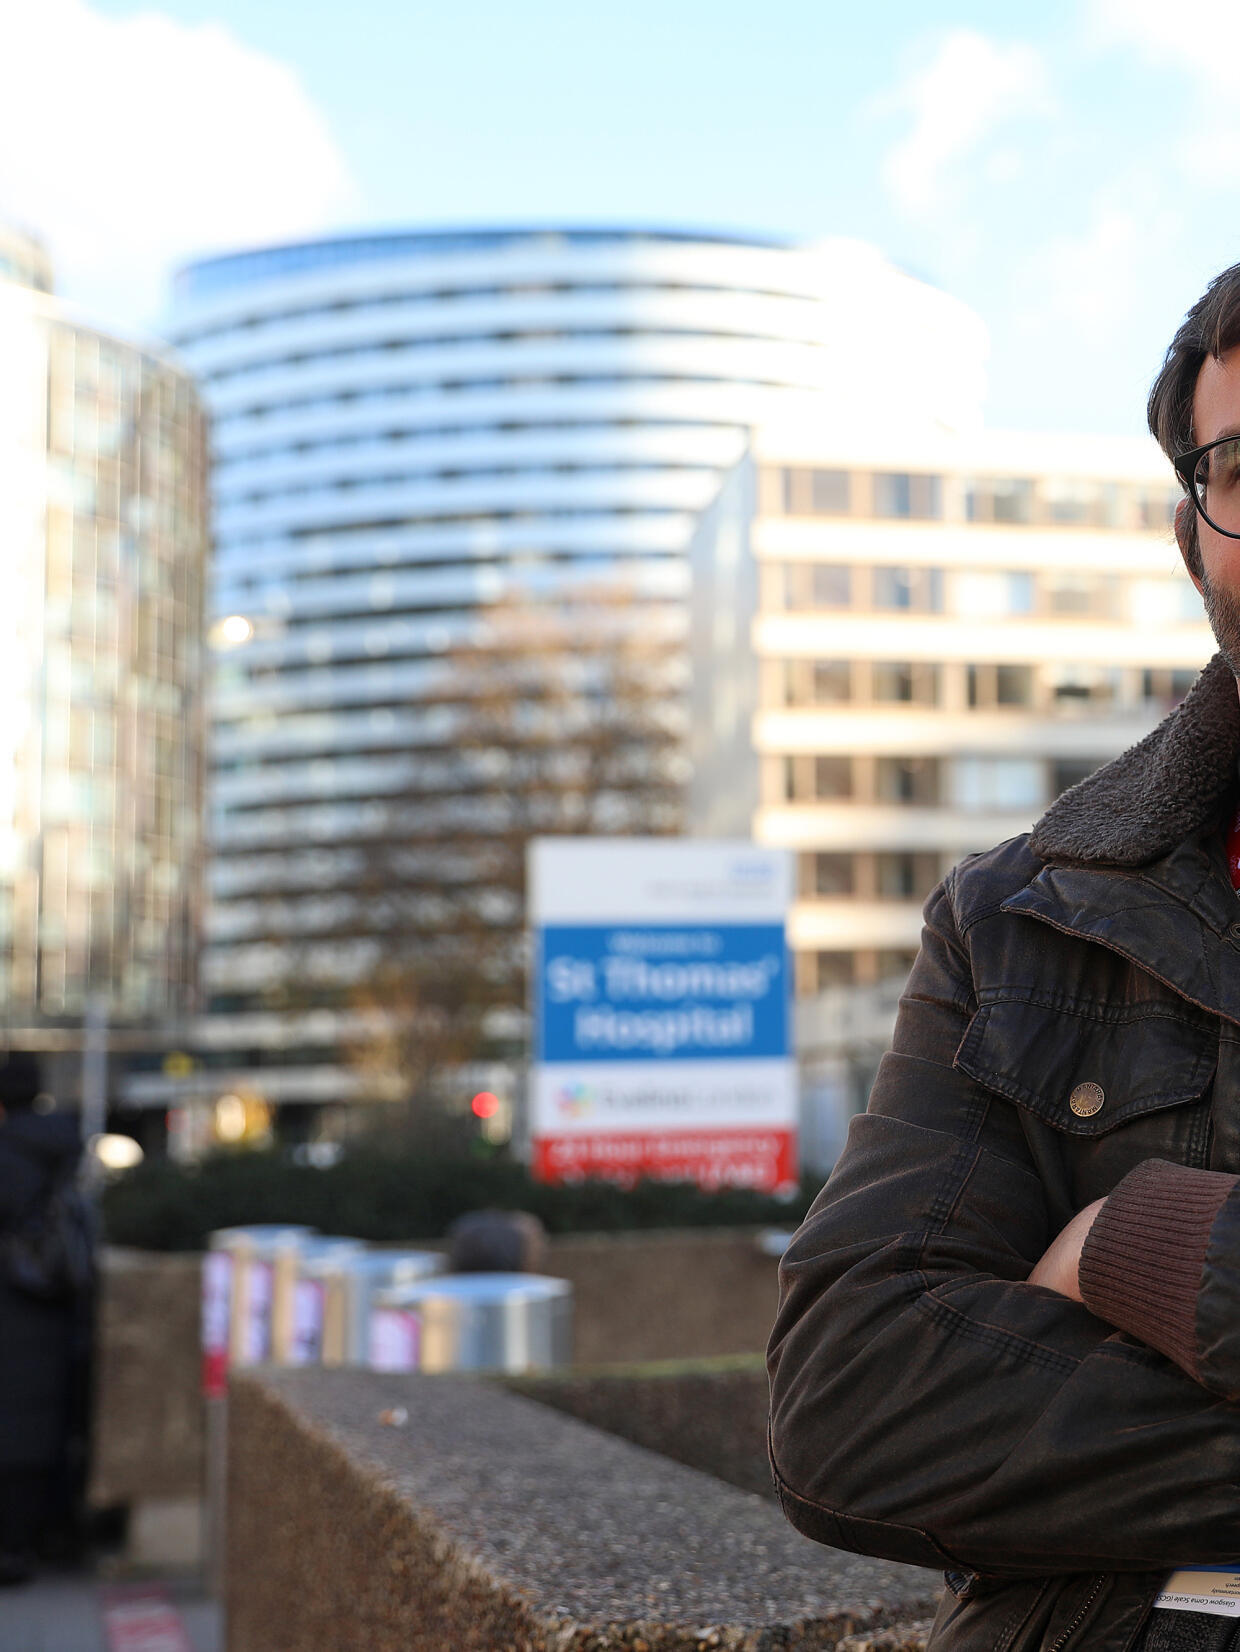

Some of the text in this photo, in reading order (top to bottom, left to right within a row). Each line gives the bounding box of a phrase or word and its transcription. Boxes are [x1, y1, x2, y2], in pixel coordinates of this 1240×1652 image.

[551, 956, 777, 999] St Thomas'
[577, 1004, 752, 1052] Hospital
[1174, 1596, 1189, 1604] Scale
[1209, 1599, 1236, 1607] Glasgow
